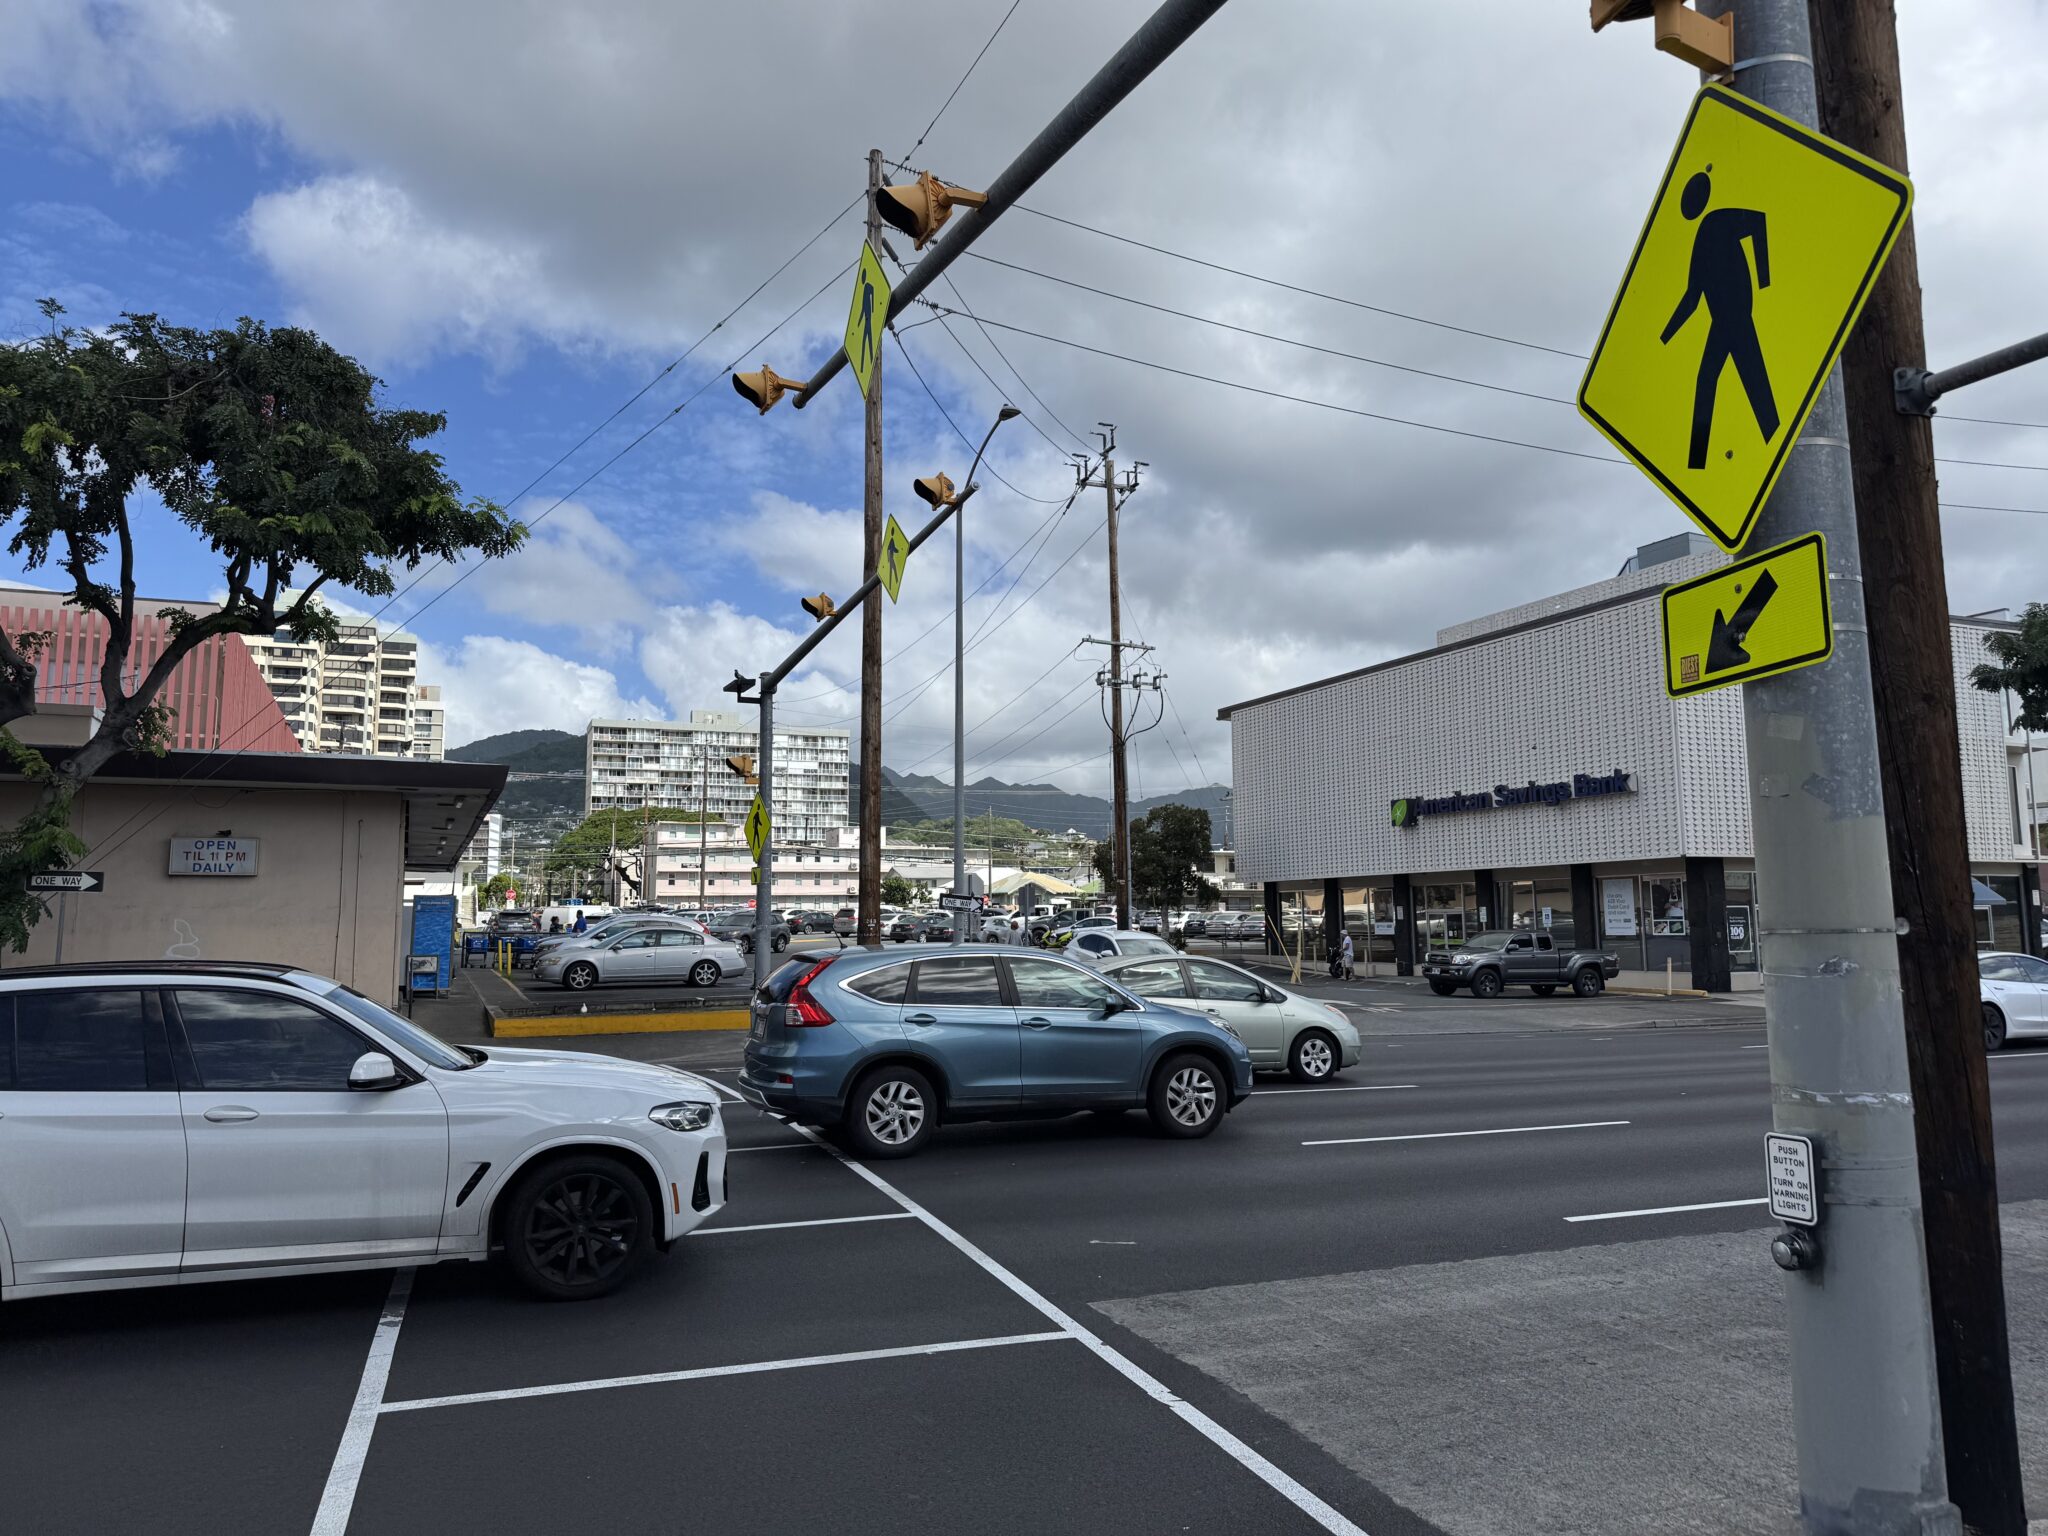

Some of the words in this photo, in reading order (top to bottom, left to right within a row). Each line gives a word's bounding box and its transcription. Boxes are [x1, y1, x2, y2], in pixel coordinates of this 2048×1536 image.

[1413, 791, 1493, 816] American
[1493, 780, 1572, 807] Savings
[1573, 768, 1635, 798] Bank
[194, 840, 236, 850] OPEN
[183, 851, 205, 861] TIL
[225, 851, 246, 861] PM
[192, 863, 234, 872] DAILY
[35, 876, 57, 885] ONE
[61, 876, 82, 886] WAY
[944, 898, 957, 906] ONE
[959, 899, 971, 907] WAY
[1778, 1146, 1798, 1155] PUSH
[1773, 1156, 1805, 1167] BUTTON
[1784, 1168, 1795, 1177] TO
[1773, 1177, 1793, 1187] TURN
[1797, 1181, 1808, 1190] ON
[1773, 1188, 1809, 1201] WARNING
[1778, 1200, 1806, 1212] LIGHTS
